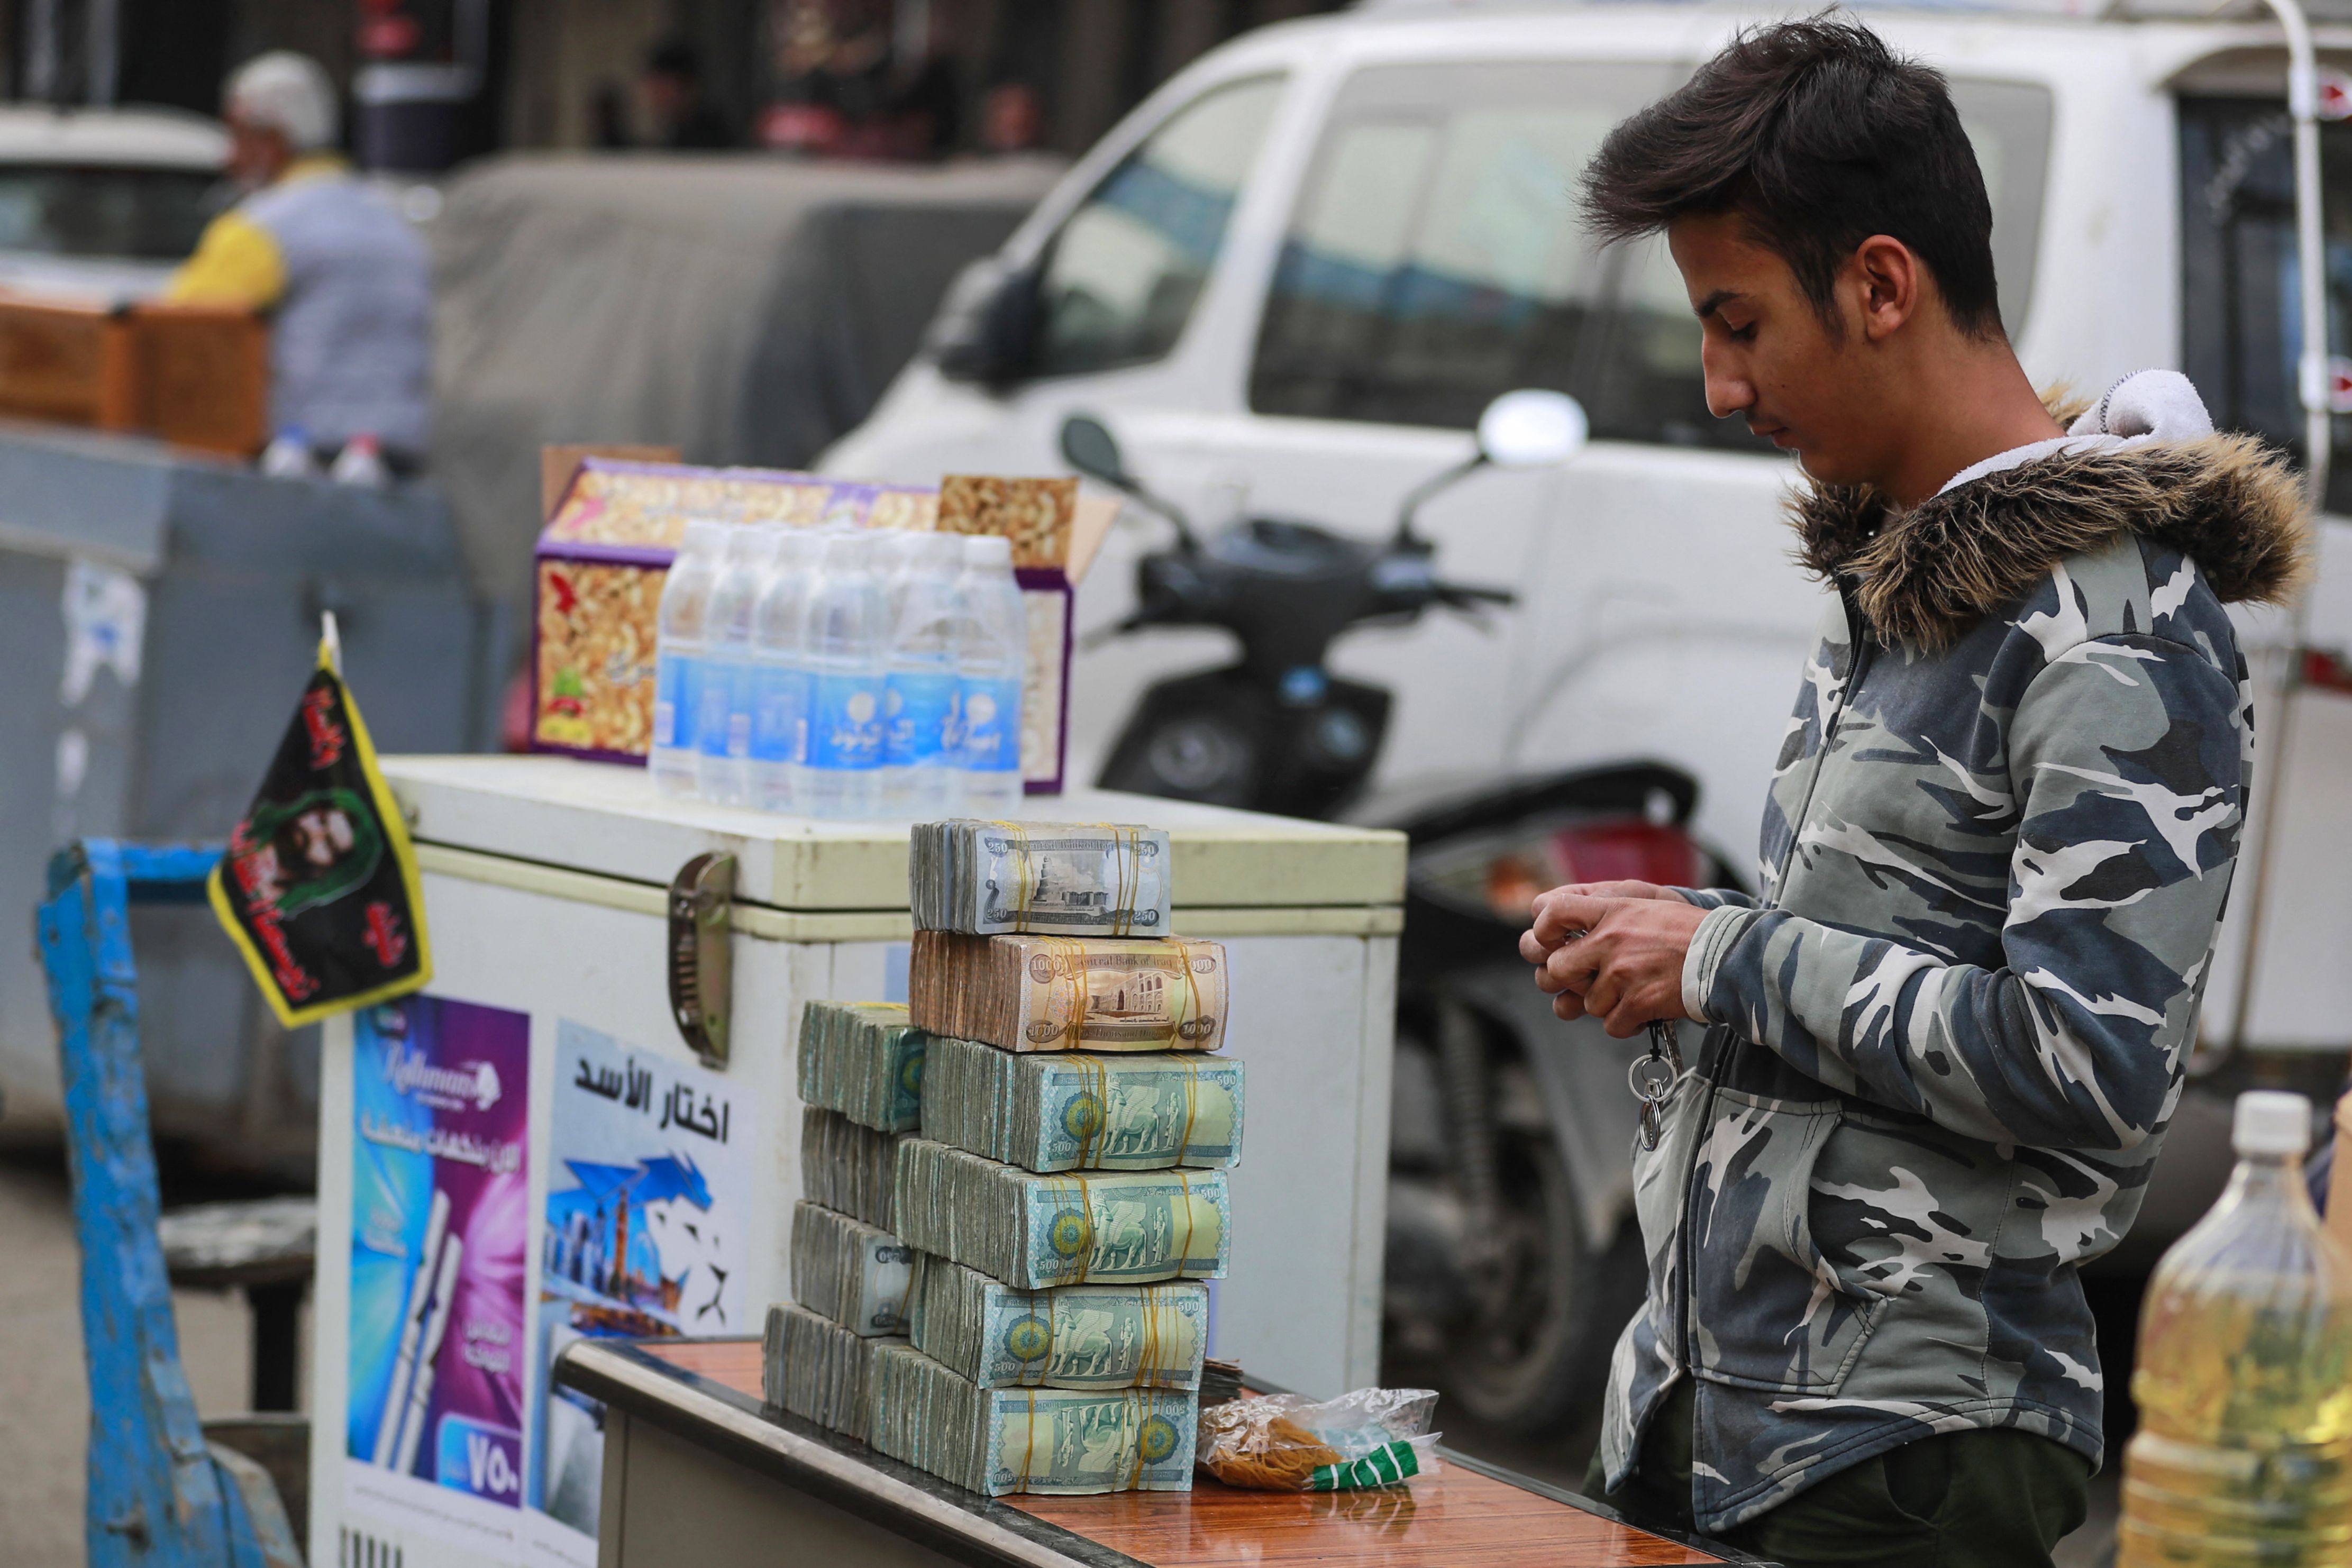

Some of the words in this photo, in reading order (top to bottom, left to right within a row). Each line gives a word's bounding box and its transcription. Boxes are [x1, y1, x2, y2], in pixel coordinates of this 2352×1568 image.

[988, 842, 1008, 853] 250
[987, 908, 1007, 919] 250
[1133, 910, 1156, 921] 250
[1033, 960, 1061, 971] 1000
[1116, 955, 1138, 966] Bank
[1141, 956, 1150, 966] of
[1153, 956, 1172, 968] Iraq
[1187, 959, 1213, 971] 000
[1029, 1024, 1059, 1037] 1000
[575, 1056, 652, 1115] الأسد
[1217, 1075, 1237, 1086] 500
[659, 1081, 730, 1144] اختار
[1052, 1142, 1071, 1152] 500
[1201, 1188, 1220, 1199] 500
[1040, 1260, 1059, 1270] 500
[1178, 1301, 1200, 1312] 500
[995, 1362, 1015, 1372] 500
[1165, 1404, 1186, 1415] 500
[993, 1472, 1014, 1482] 500
